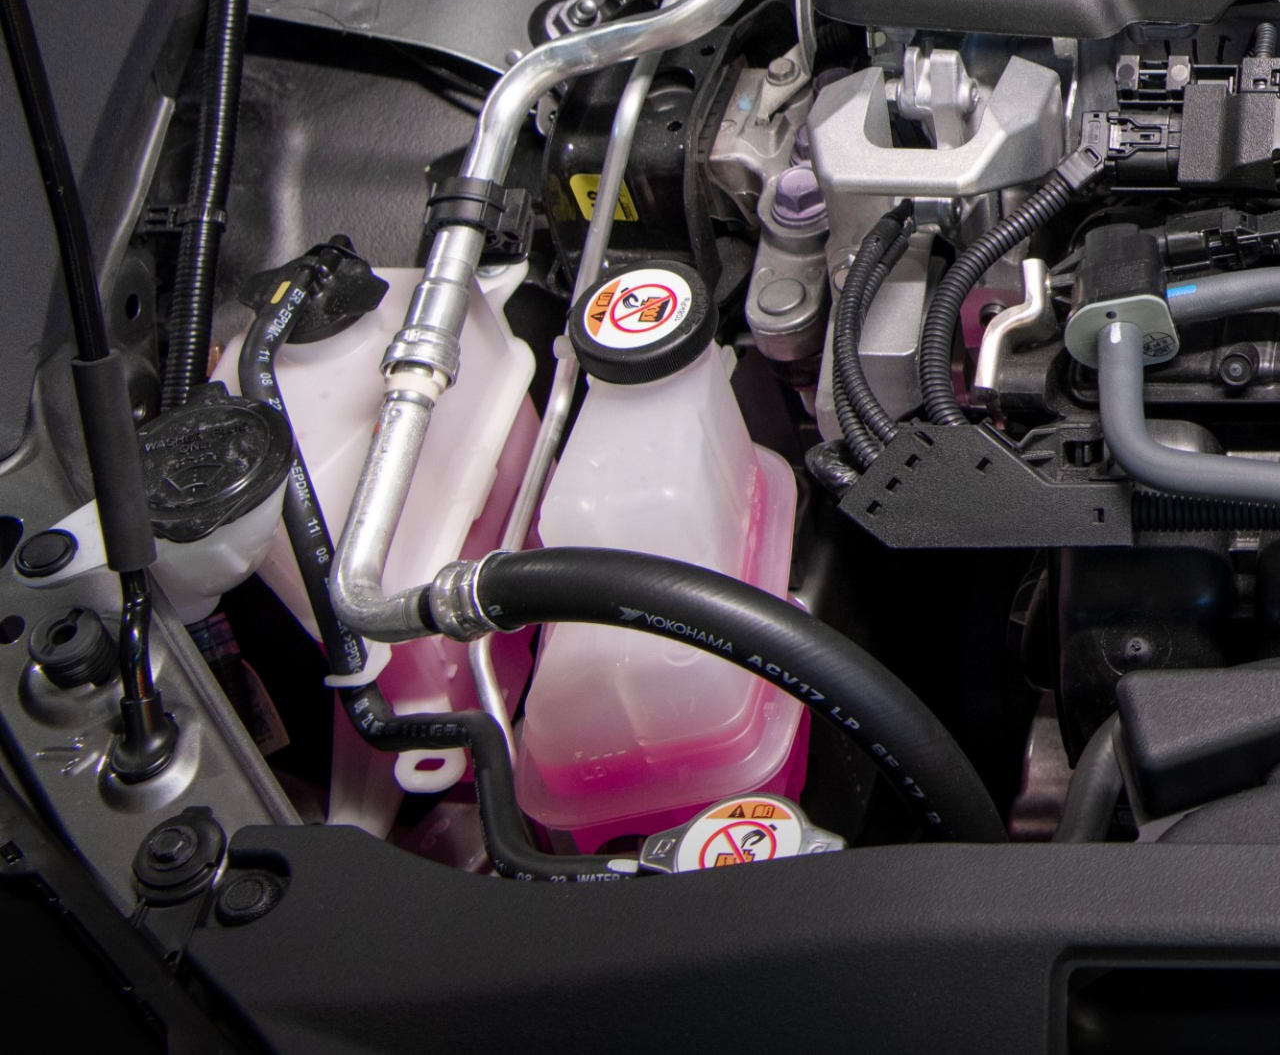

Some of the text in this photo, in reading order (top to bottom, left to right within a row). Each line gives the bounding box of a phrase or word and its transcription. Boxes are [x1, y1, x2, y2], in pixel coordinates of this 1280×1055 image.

[315, 547, 330, 564] 08
[643, 613, 734, 655] YOKOHAMA
[743, 654, 827, 703] ACV17
[829, 705, 862, 732] LP
